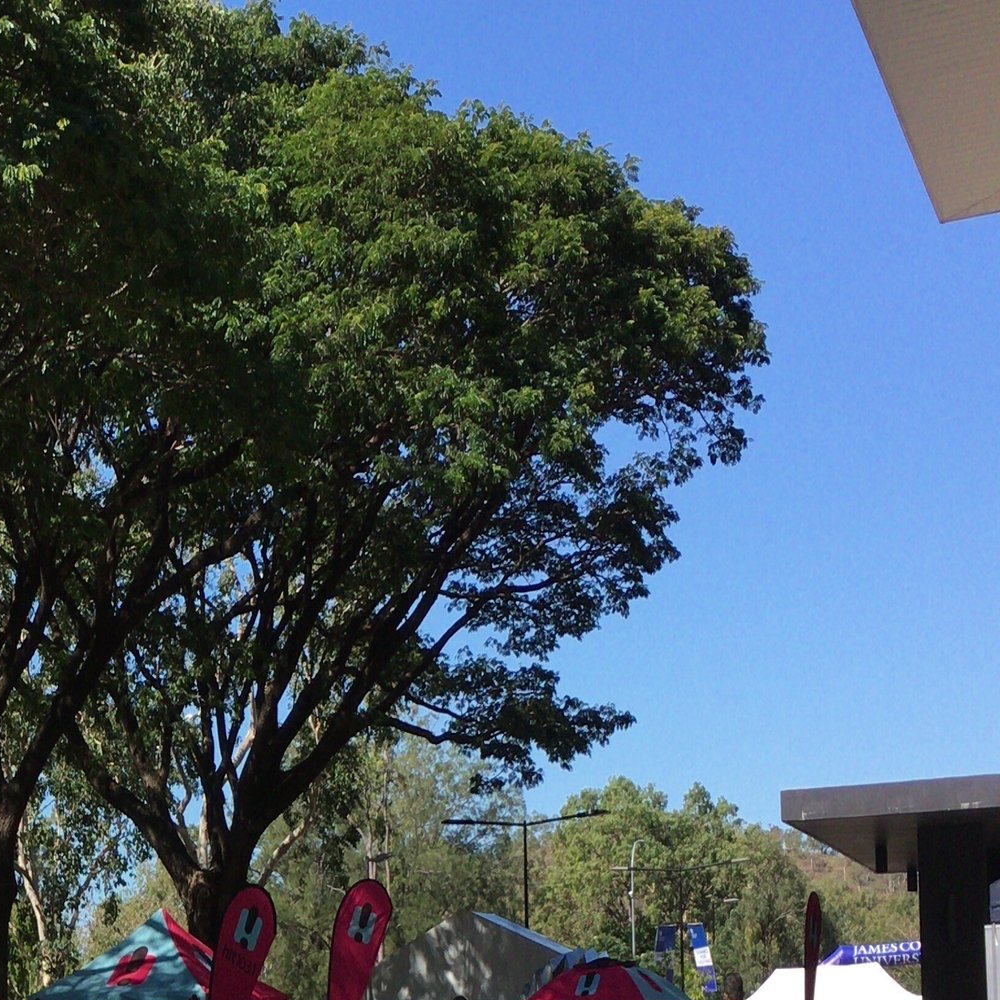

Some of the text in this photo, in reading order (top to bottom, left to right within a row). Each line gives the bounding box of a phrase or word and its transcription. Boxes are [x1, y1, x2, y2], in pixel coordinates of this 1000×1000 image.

[854, 940, 921, 956] JAMES CO
[854, 952, 921, 965] UNIVERS
